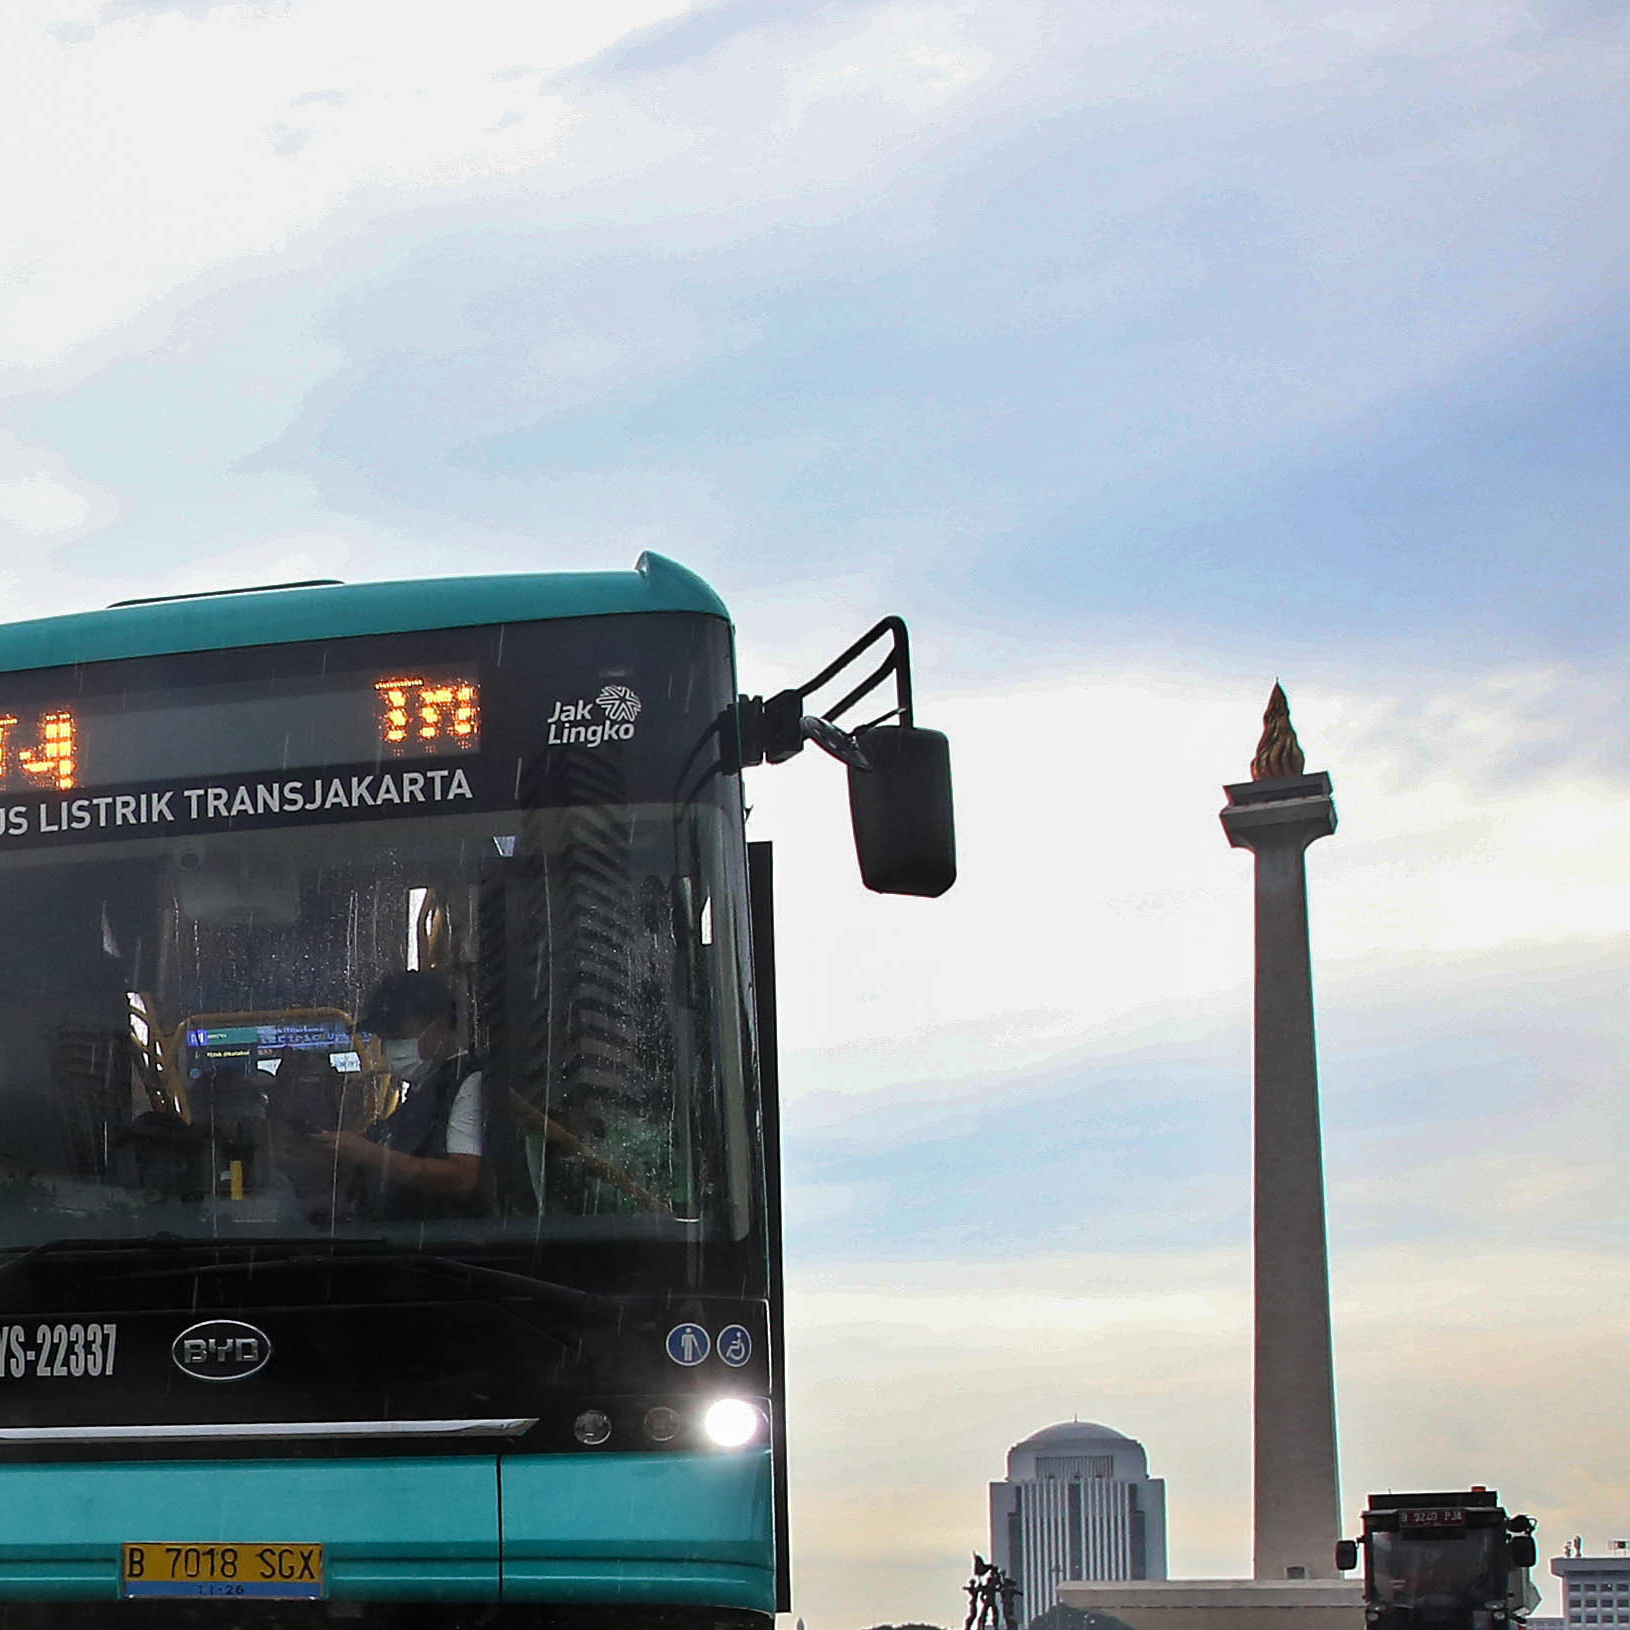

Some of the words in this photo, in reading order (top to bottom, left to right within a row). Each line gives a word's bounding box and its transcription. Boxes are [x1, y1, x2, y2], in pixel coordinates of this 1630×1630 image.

[547, 700, 594, 723] Jak
[547, 719, 636, 748] Lingko
[40, 791, 175, 833] LISTRIK
[183, 768, 474, 819] TRANSJAKARTA
[183, 1338, 260, 1364] BYD
[127, 1547, 145, 1578] B
[165, 1547, 239, 1579] 7018
[255, 1548, 316, 1580] SGX
